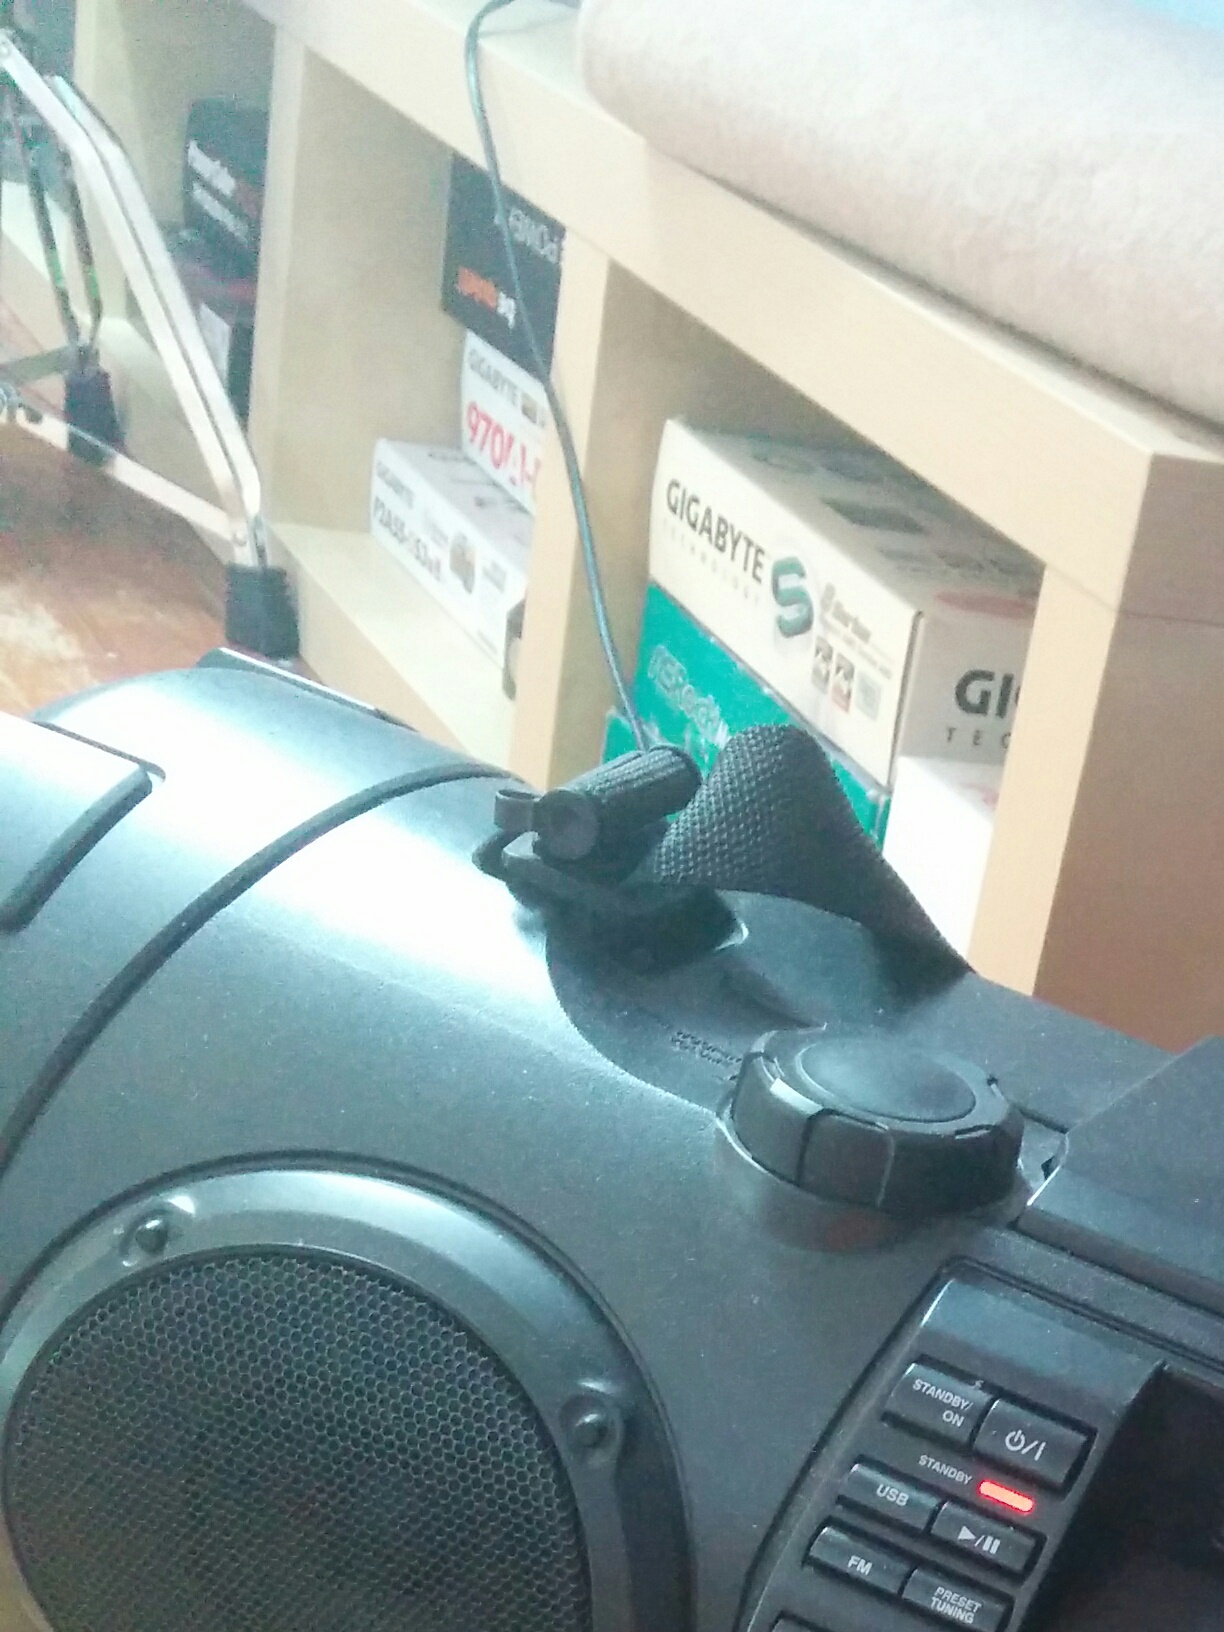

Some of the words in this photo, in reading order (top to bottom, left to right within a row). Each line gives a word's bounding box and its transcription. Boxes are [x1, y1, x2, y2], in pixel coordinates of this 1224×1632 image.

[666, 478, 766, 584] GIGABYTE
[912, 1378, 974, 1412] STANDBY/
[942, 1409, 965, 1428] ON
[918, 1453, 973, 1485] STANDBY
[876, 1483, 910, 1507] USB
[847, 1554, 873, 1576] FM
[930, 1597, 975, 1625] TUNING
[934, 1586, 982, 1613] PRESET
